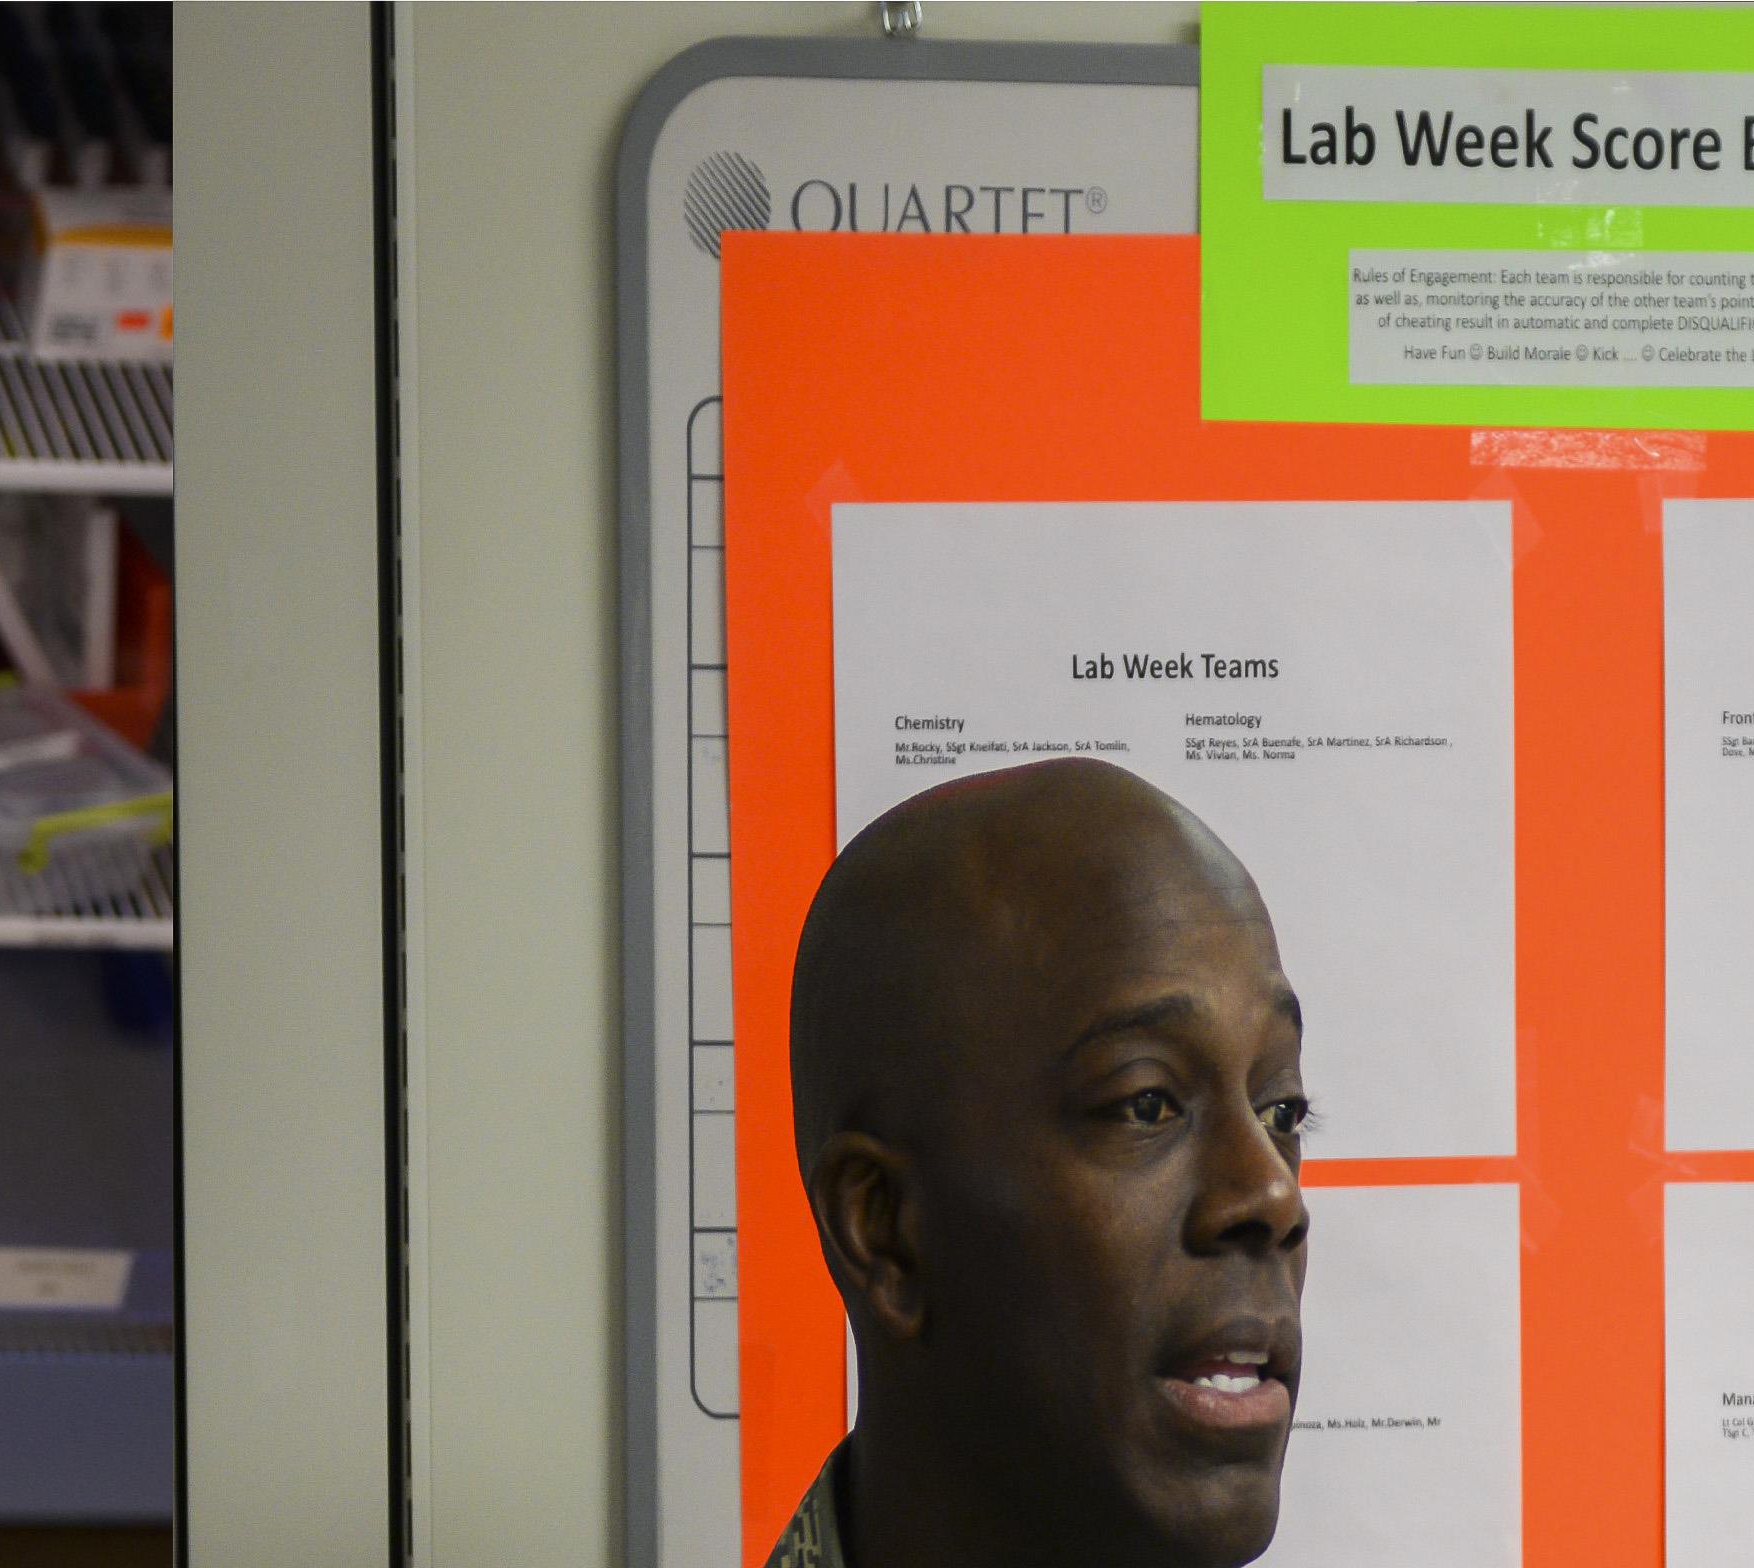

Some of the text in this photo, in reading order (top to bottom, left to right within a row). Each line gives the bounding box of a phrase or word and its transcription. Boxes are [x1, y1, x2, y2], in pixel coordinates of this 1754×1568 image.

[1278, 105, 1376, 169] Lab
[1396, 106, 1554, 172] Week
[1572, 111, 1724, 174] Score
[1353, 268, 1389, 283] Rules
[1392, 268, 1406, 283] of
[1501, 269, 1532, 284] Each
[1536, 271, 1569, 285] team
[1573, 270, 1584, 284] is
[1587, 271, 1663, 288] responsible
[1667, 271, 1686, 285] for
[1689, 272, 1747, 289] counting
[1355, 296, 1370, 306] as
[1374, 291, 1401, 306] well
[1404, 296, 1423, 309] as,
[1427, 293, 1500, 310] monitoring
[1504, 293, 1526, 307] the
[1530, 297, 1586, 310] accuracy
[1591, 293, 1605, 307] of
[1608, 292, 1630, 307] the
[1633, 294, 1669, 308] other
[1673, 295, 1717, 309] team's
[1378, 314, 1392, 328] of
[1395, 314, 1453, 332] cheating
[1455, 314, 1494, 329] result
[1498, 315, 1510, 329] in
[1514, 315, 1581, 330] automatic
[1584, 316, 1609, 330] and
[1612, 316, 1674, 333] complete
[1404, 345, 1438, 362] Have
[1441, 345, 1466, 362] Fun
[1487, 345, 1522, 362] Build
[1525, 346, 1571, 362] Morale
[1592, 346, 1619, 362] Kick
[1659, 346, 1723, 363] Celebrate
[1726, 348, 1746, 362] the
[1072, 653, 1279, 680] Lab Week Teams
[894, 715, 965, 734] Chemistry
[1185, 712, 1262, 730] Hematology
[946, 741, 967, 754] SSgt
[1013, 741, 1029, 752] SrA
[1032, 740, 1072, 754] Jackson,
[1075, 740, 1091, 751] SrA
[1094, 740, 1131, 753] Tomlin,
[1185, 737, 1205, 750] SSgt
[1209, 737, 1239, 751] Reyes,
[1243, 738, 1259, 749] SrA
[1307, 737, 1324, 748] SrA
[1326, 736, 1372, 750] Martinez,
[1375, 736, 1391, 748] SrA
[1722, 735, 1740, 748] SSgt
[1185, 749, 1296, 763] Ms. Vivian, Ms. Norma
